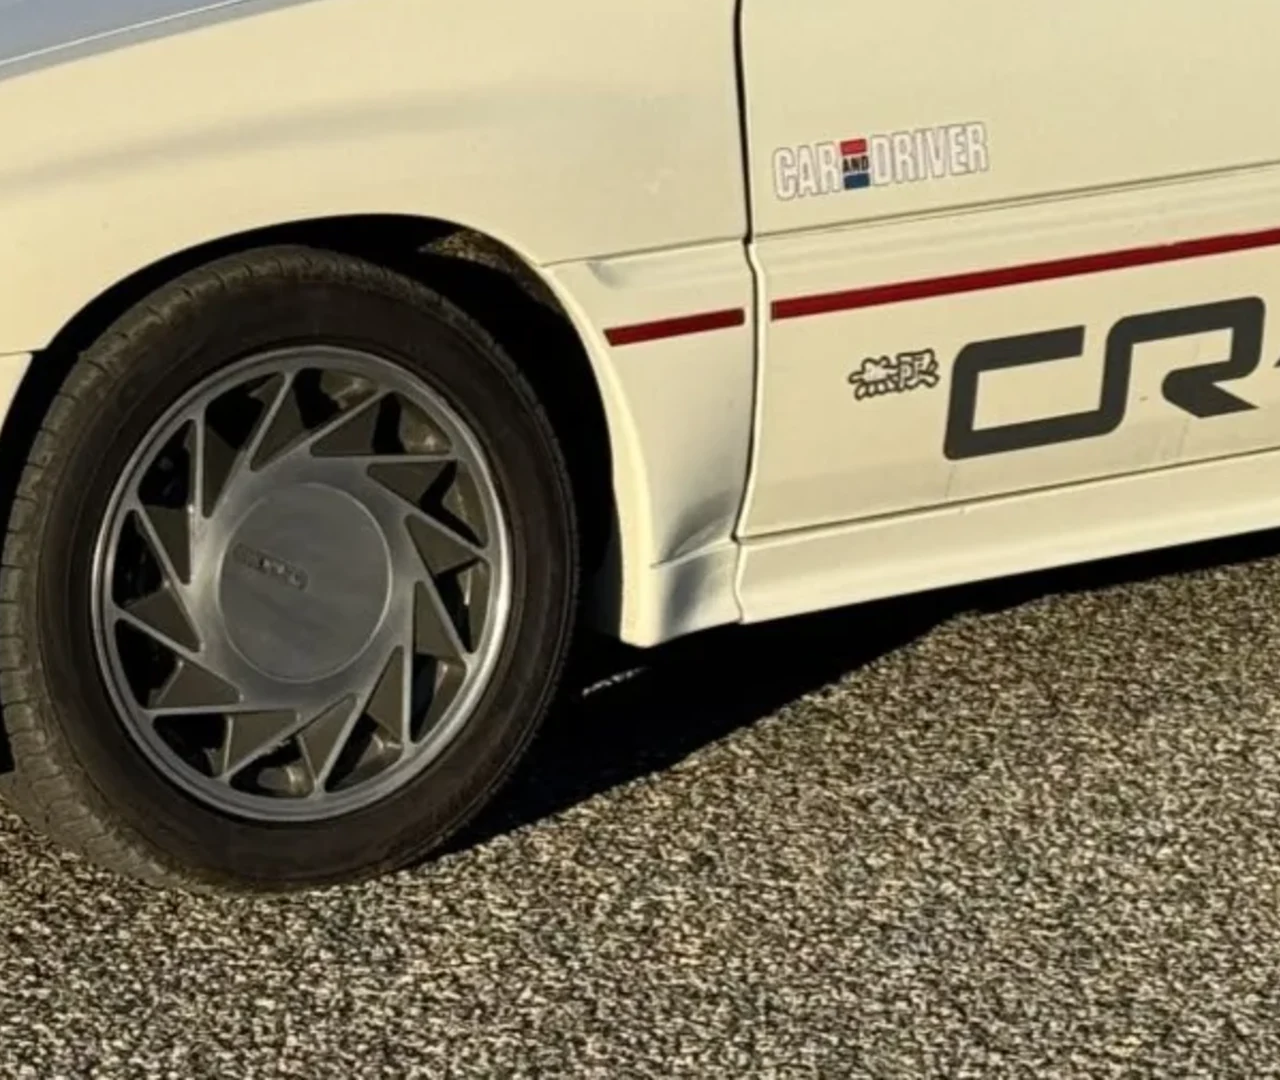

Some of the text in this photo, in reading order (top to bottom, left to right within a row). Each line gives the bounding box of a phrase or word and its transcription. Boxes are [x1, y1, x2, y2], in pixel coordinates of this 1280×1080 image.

[773, 120, 989, 201] CAR AND DRIVER
